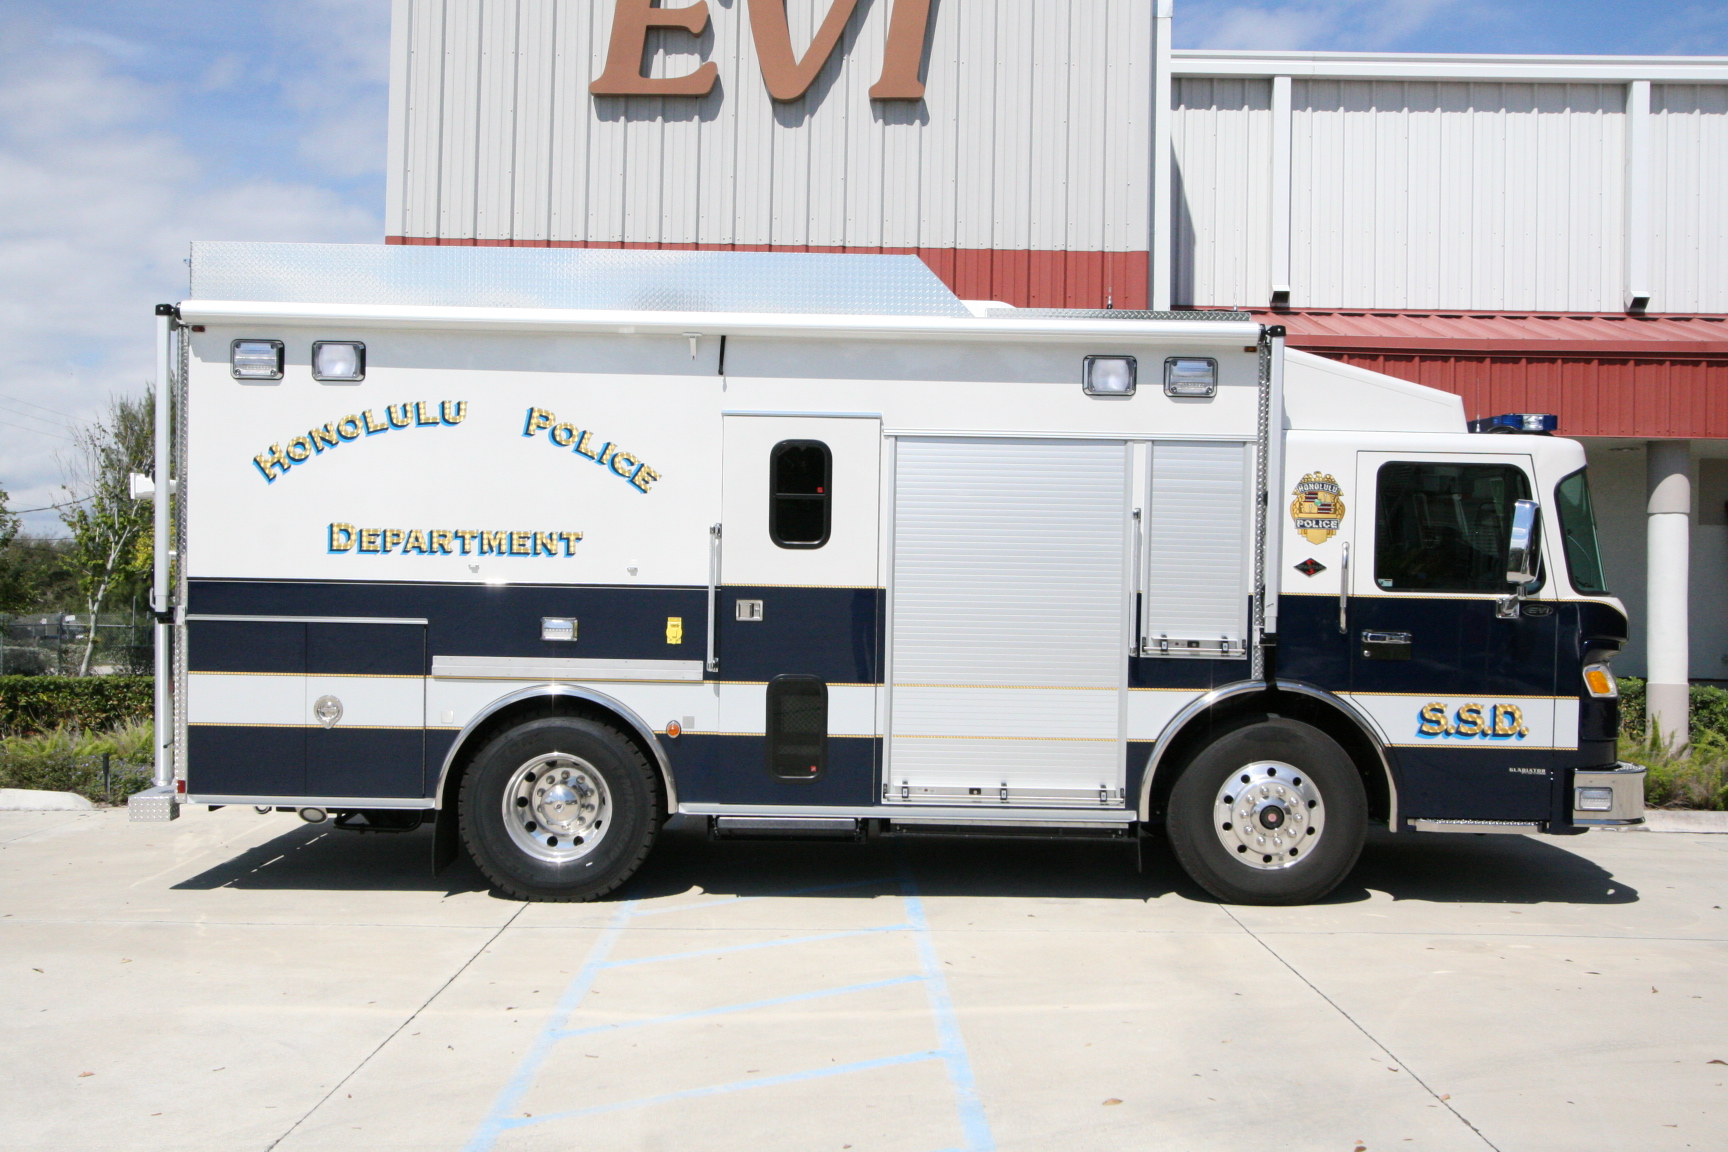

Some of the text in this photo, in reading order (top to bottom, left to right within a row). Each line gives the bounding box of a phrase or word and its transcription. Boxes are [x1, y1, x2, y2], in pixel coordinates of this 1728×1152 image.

[588, 0, 931, 101] EVI
[1298, 482, 1338, 493] HONOLULU
[1296, 519, 1338, 528] POLICE
[1415, 702, 1529, 741] S.S.D.
